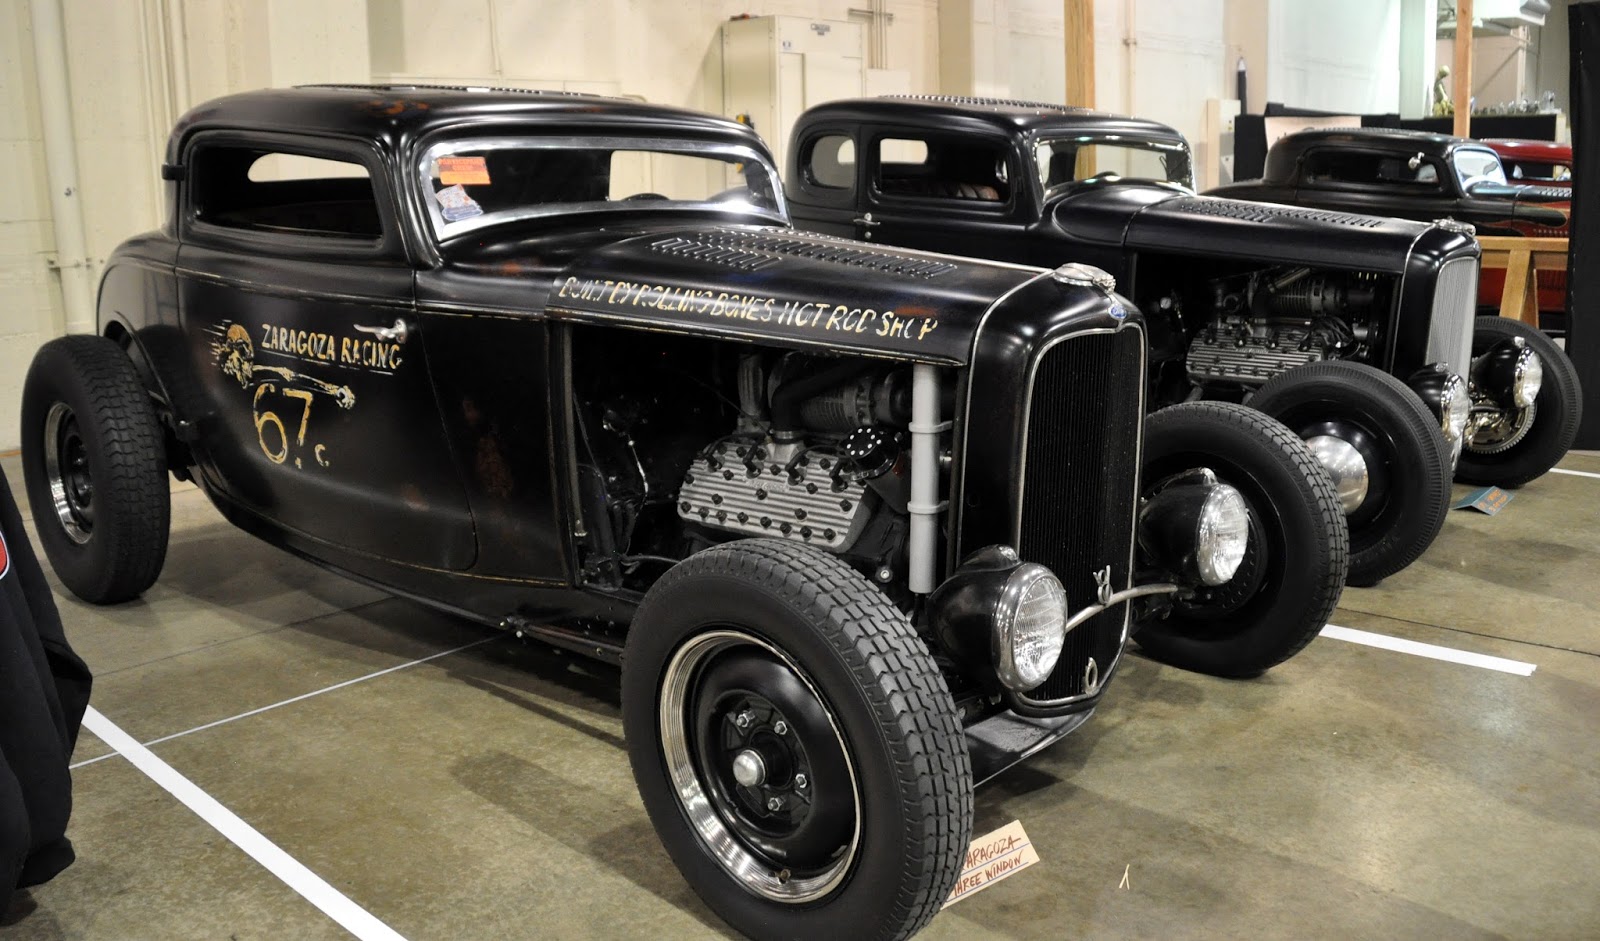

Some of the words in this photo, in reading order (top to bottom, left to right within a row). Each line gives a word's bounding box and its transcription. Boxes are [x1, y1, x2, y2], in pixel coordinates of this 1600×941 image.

[633, 283, 713, 313] ROLLING
[709, 292, 775, 322] BONES
[777, 301, 831, 328] HOT
[825, 305, 877, 334] ROD
[261, 323, 336, 361] ZARAGOZA
[340, 336, 403, 370] RACING
[966, 834, 1022, 868] ARAGOZA
[984, 848, 1025, 881] WINDOW
